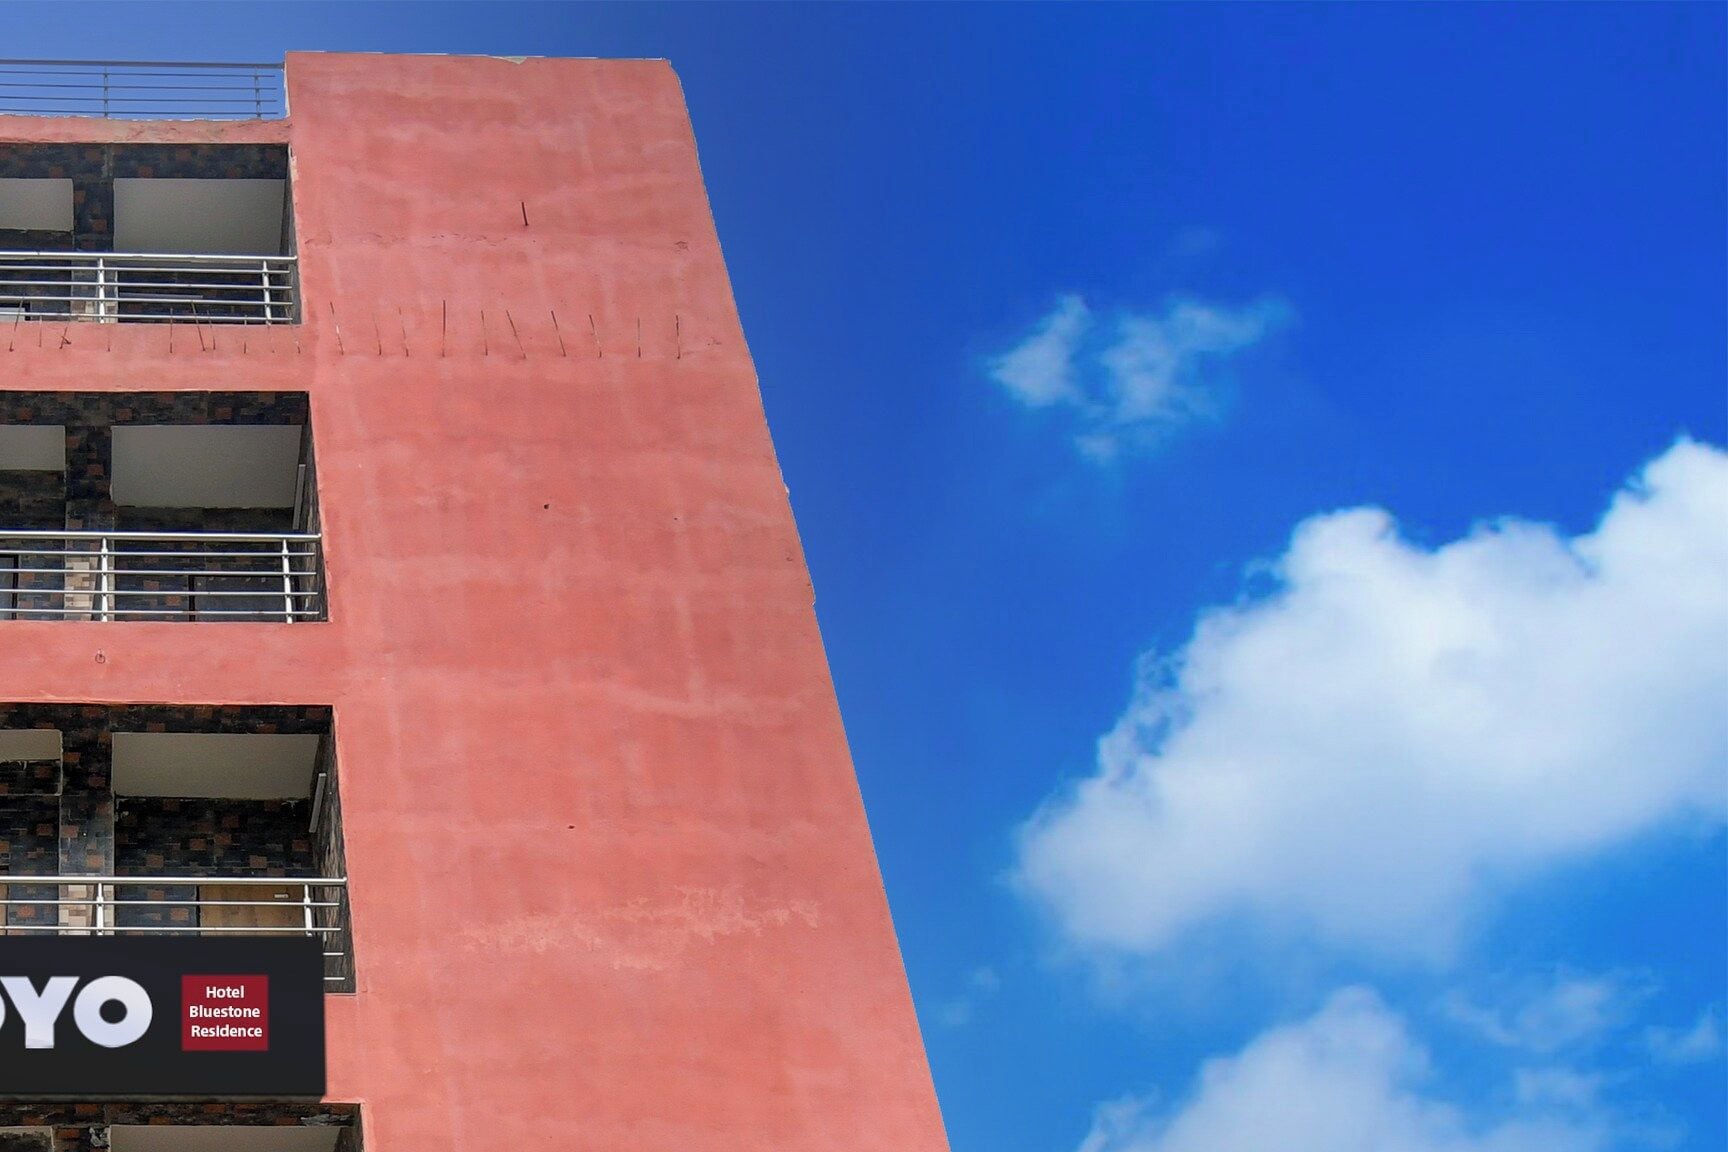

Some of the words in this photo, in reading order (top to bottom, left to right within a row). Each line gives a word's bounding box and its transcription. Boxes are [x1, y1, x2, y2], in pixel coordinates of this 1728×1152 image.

[206, 985, 245, 999] Hotel
[189, 1004, 261, 1018] Bluestone
[191, 1023, 263, 1038] Residence
